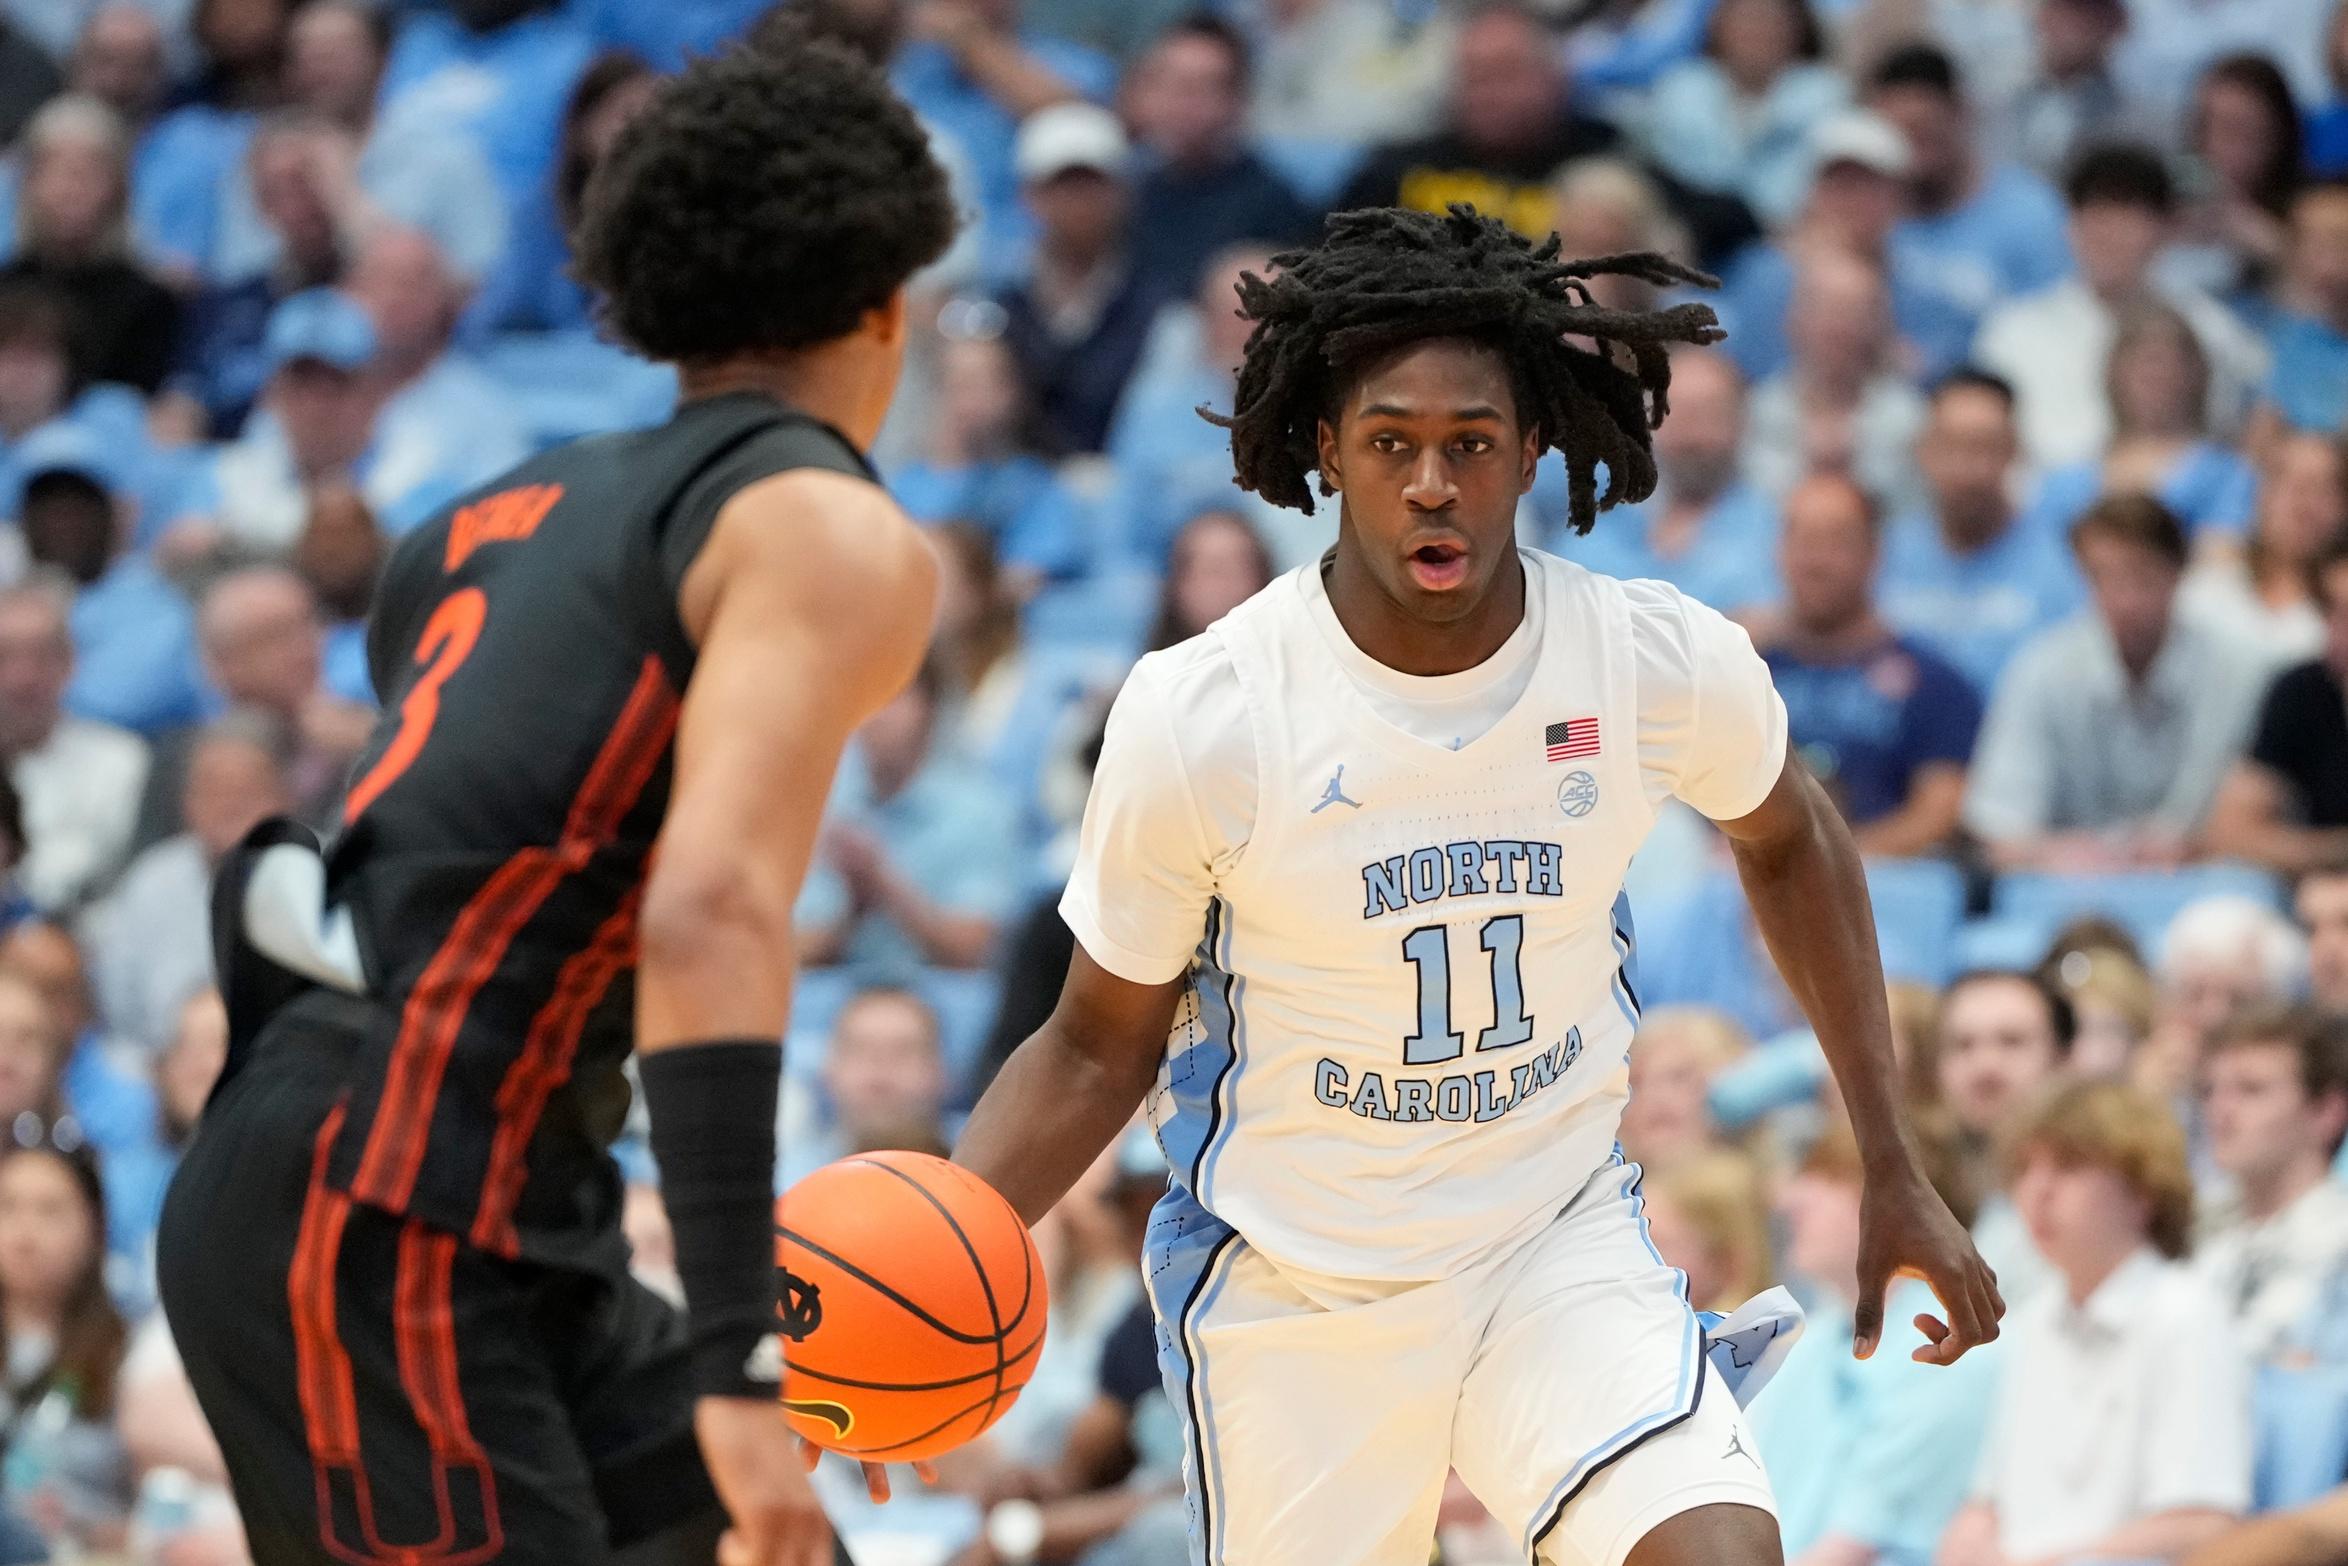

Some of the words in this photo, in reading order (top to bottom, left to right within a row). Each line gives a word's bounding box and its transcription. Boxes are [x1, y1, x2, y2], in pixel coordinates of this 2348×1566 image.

[1560, 783, 1596, 802] ACC
[1362, 841, 1563, 919] NORTH
[1402, 914, 1534, 1065] 11
[1314, 1025, 1583, 1123] CAROLINA
